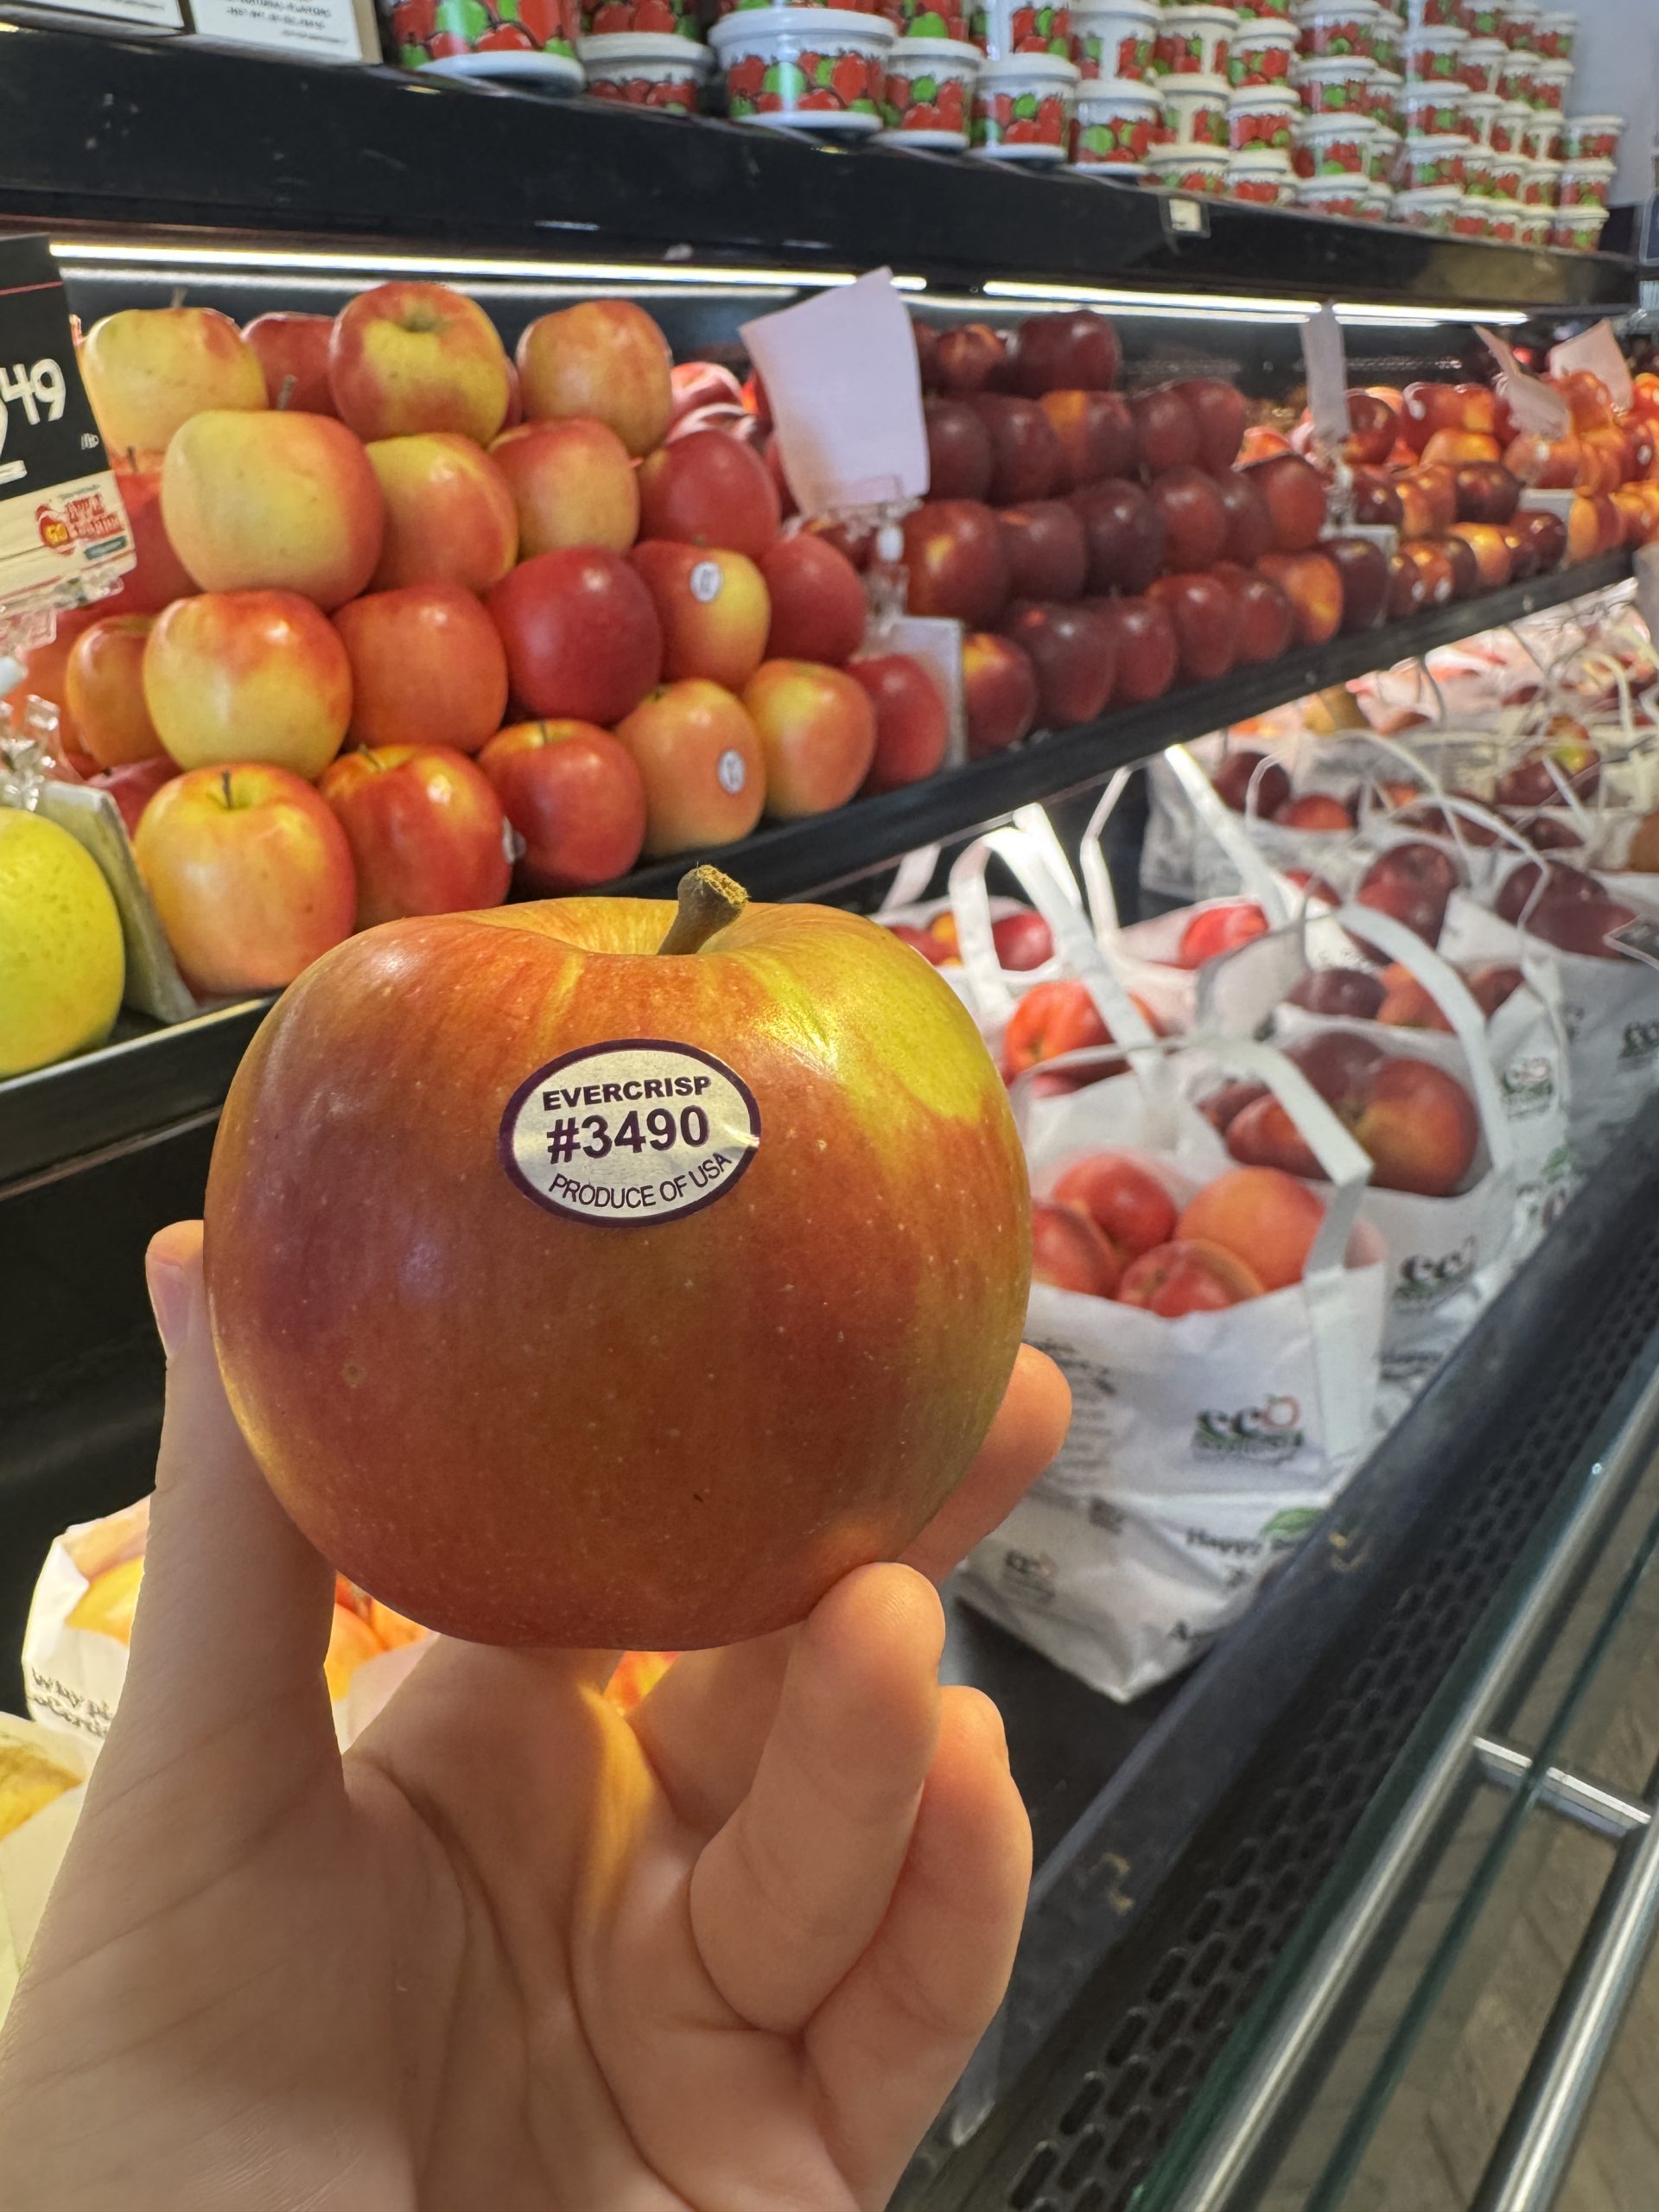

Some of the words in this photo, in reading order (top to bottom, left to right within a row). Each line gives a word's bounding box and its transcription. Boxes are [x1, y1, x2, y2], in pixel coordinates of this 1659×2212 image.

[542, 1076, 712, 1111] EVERCRISP
[546, 1104, 710, 1165] #3490
[549, 1173, 657, 1209] PRODUCE
[659, 1175, 688, 1202] OF
[689, 1152, 733, 1189] USA
